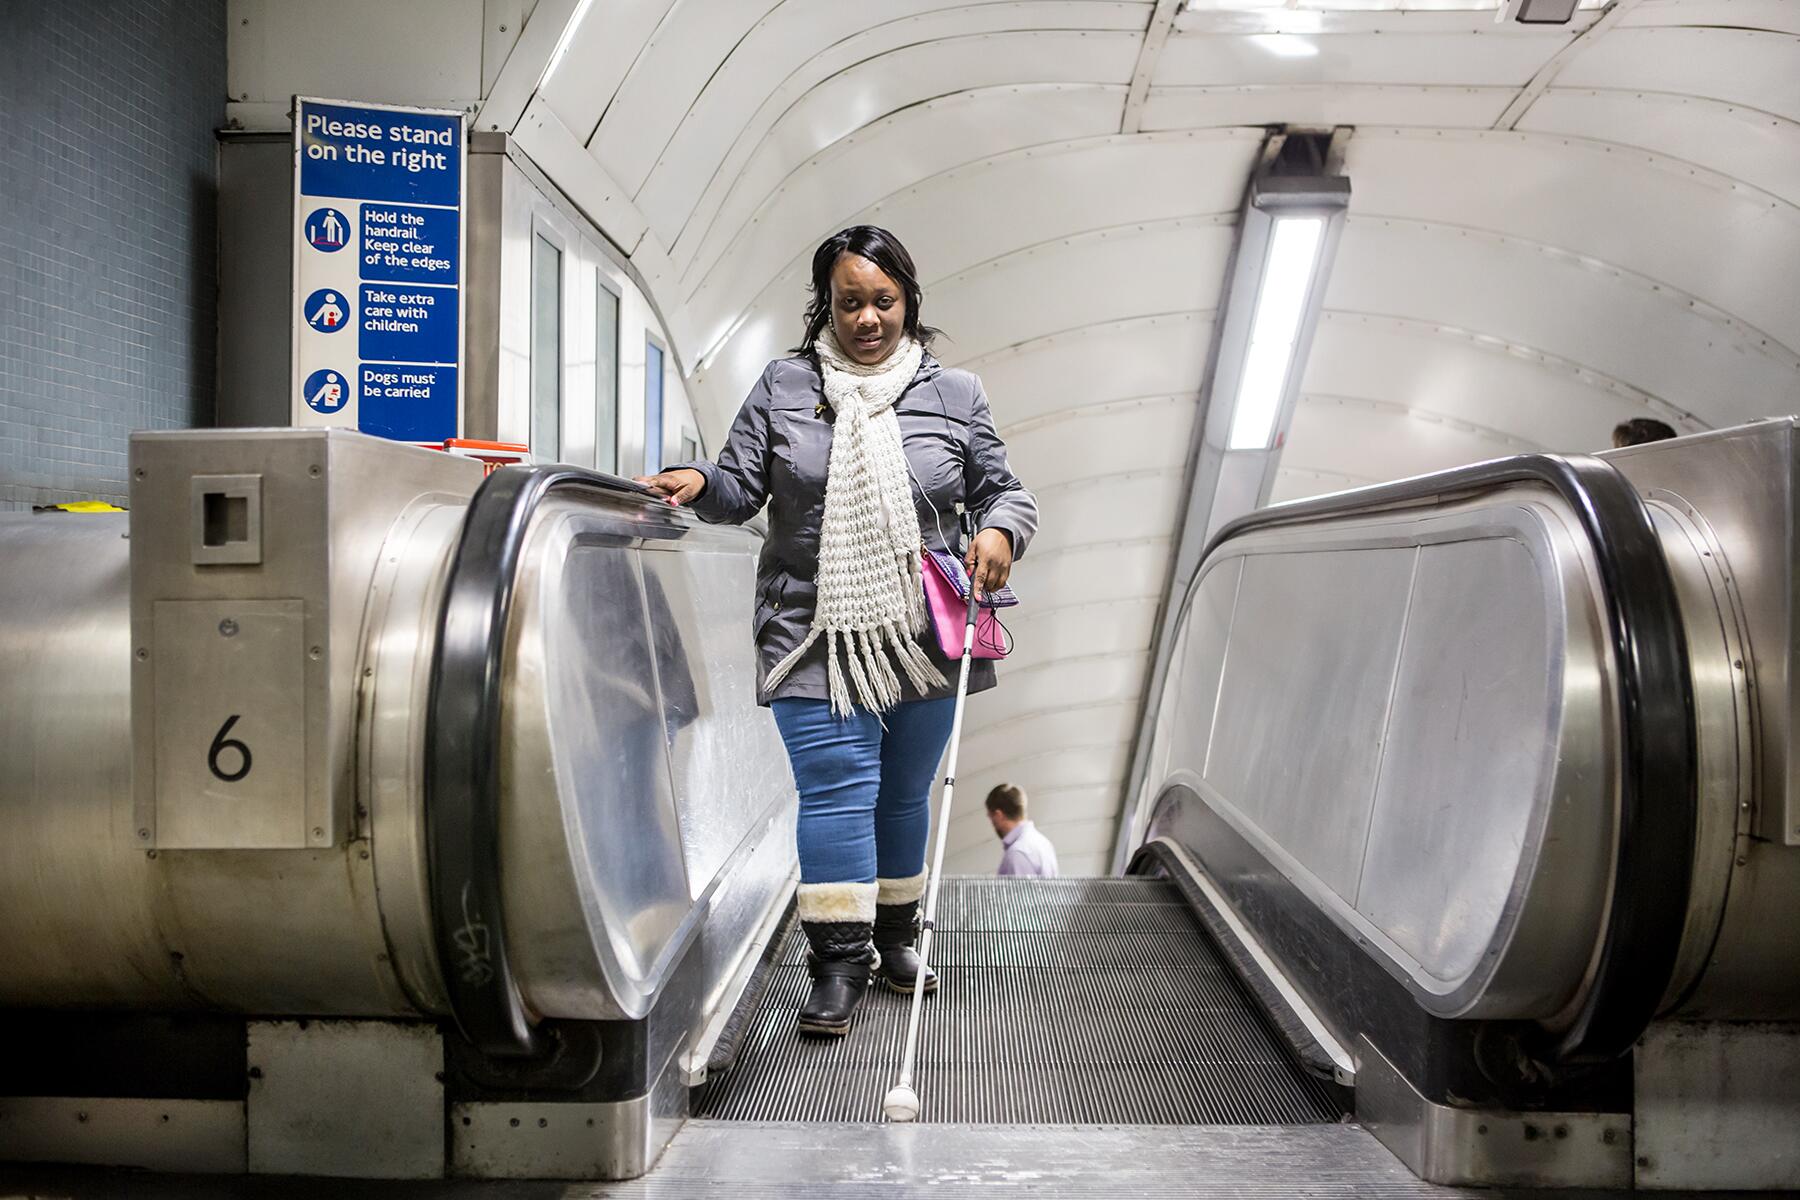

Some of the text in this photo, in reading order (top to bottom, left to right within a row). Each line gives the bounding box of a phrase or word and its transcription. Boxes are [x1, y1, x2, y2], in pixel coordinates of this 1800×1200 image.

[306, 113, 453, 147] Please stand
[306, 143, 447, 173] on the right
[364, 209, 425, 226] Hold the
[364, 225, 418, 240] handrail
[364, 238, 435, 255] Keep clear
[364, 253, 451, 271] of the edges
[364, 290, 435, 306] Take extra
[364, 305, 428, 319] care with
[364, 319, 419, 333] children
[363, 370, 436, 387] Dogs must
[363, 385, 430, 399] be carried
[208, 715, 252, 782] 6
